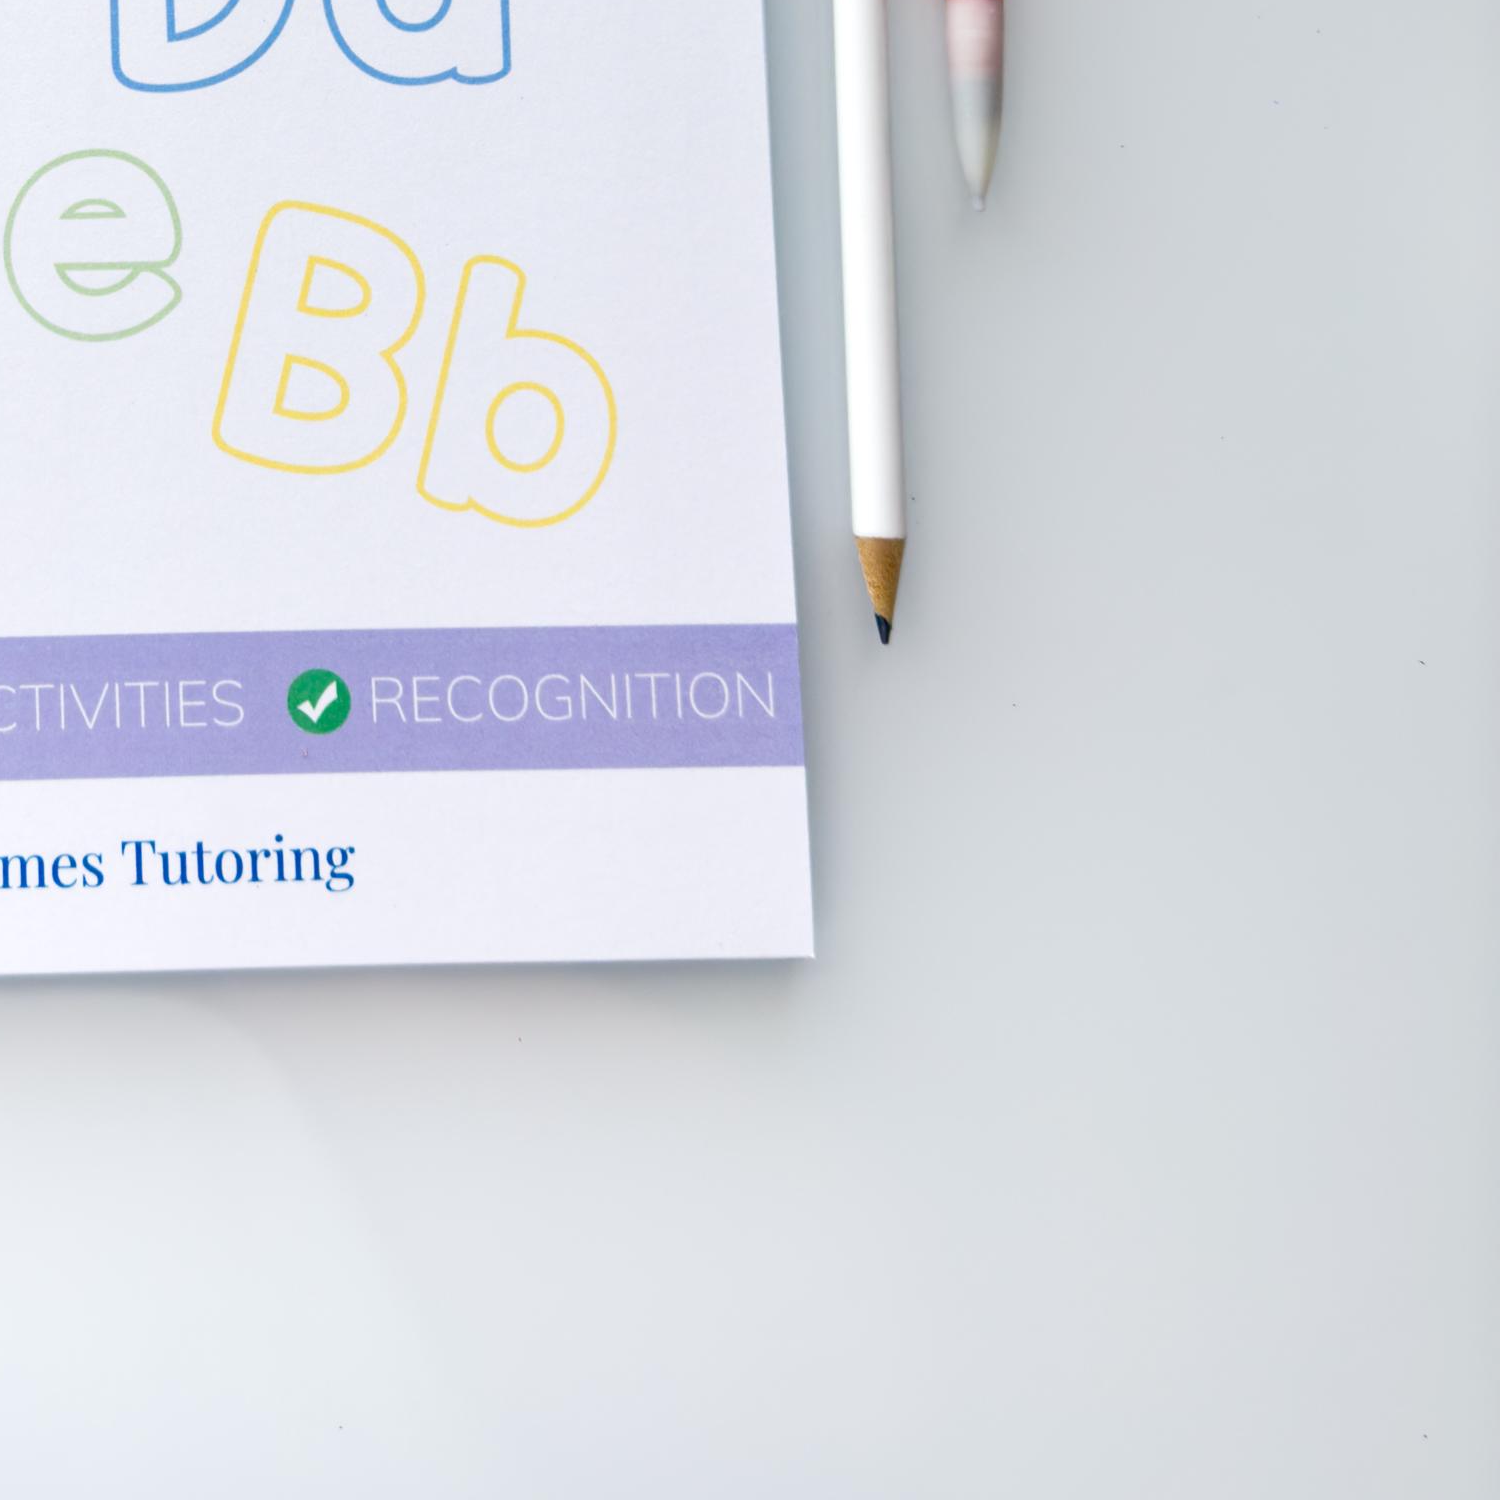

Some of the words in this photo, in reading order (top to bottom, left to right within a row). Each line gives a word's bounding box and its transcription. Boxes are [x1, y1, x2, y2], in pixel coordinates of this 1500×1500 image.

[211, 199, 618, 529] Bb
[370, 672, 776, 724] RECOGNITION
[121, 834, 355, 892] Tutoring
